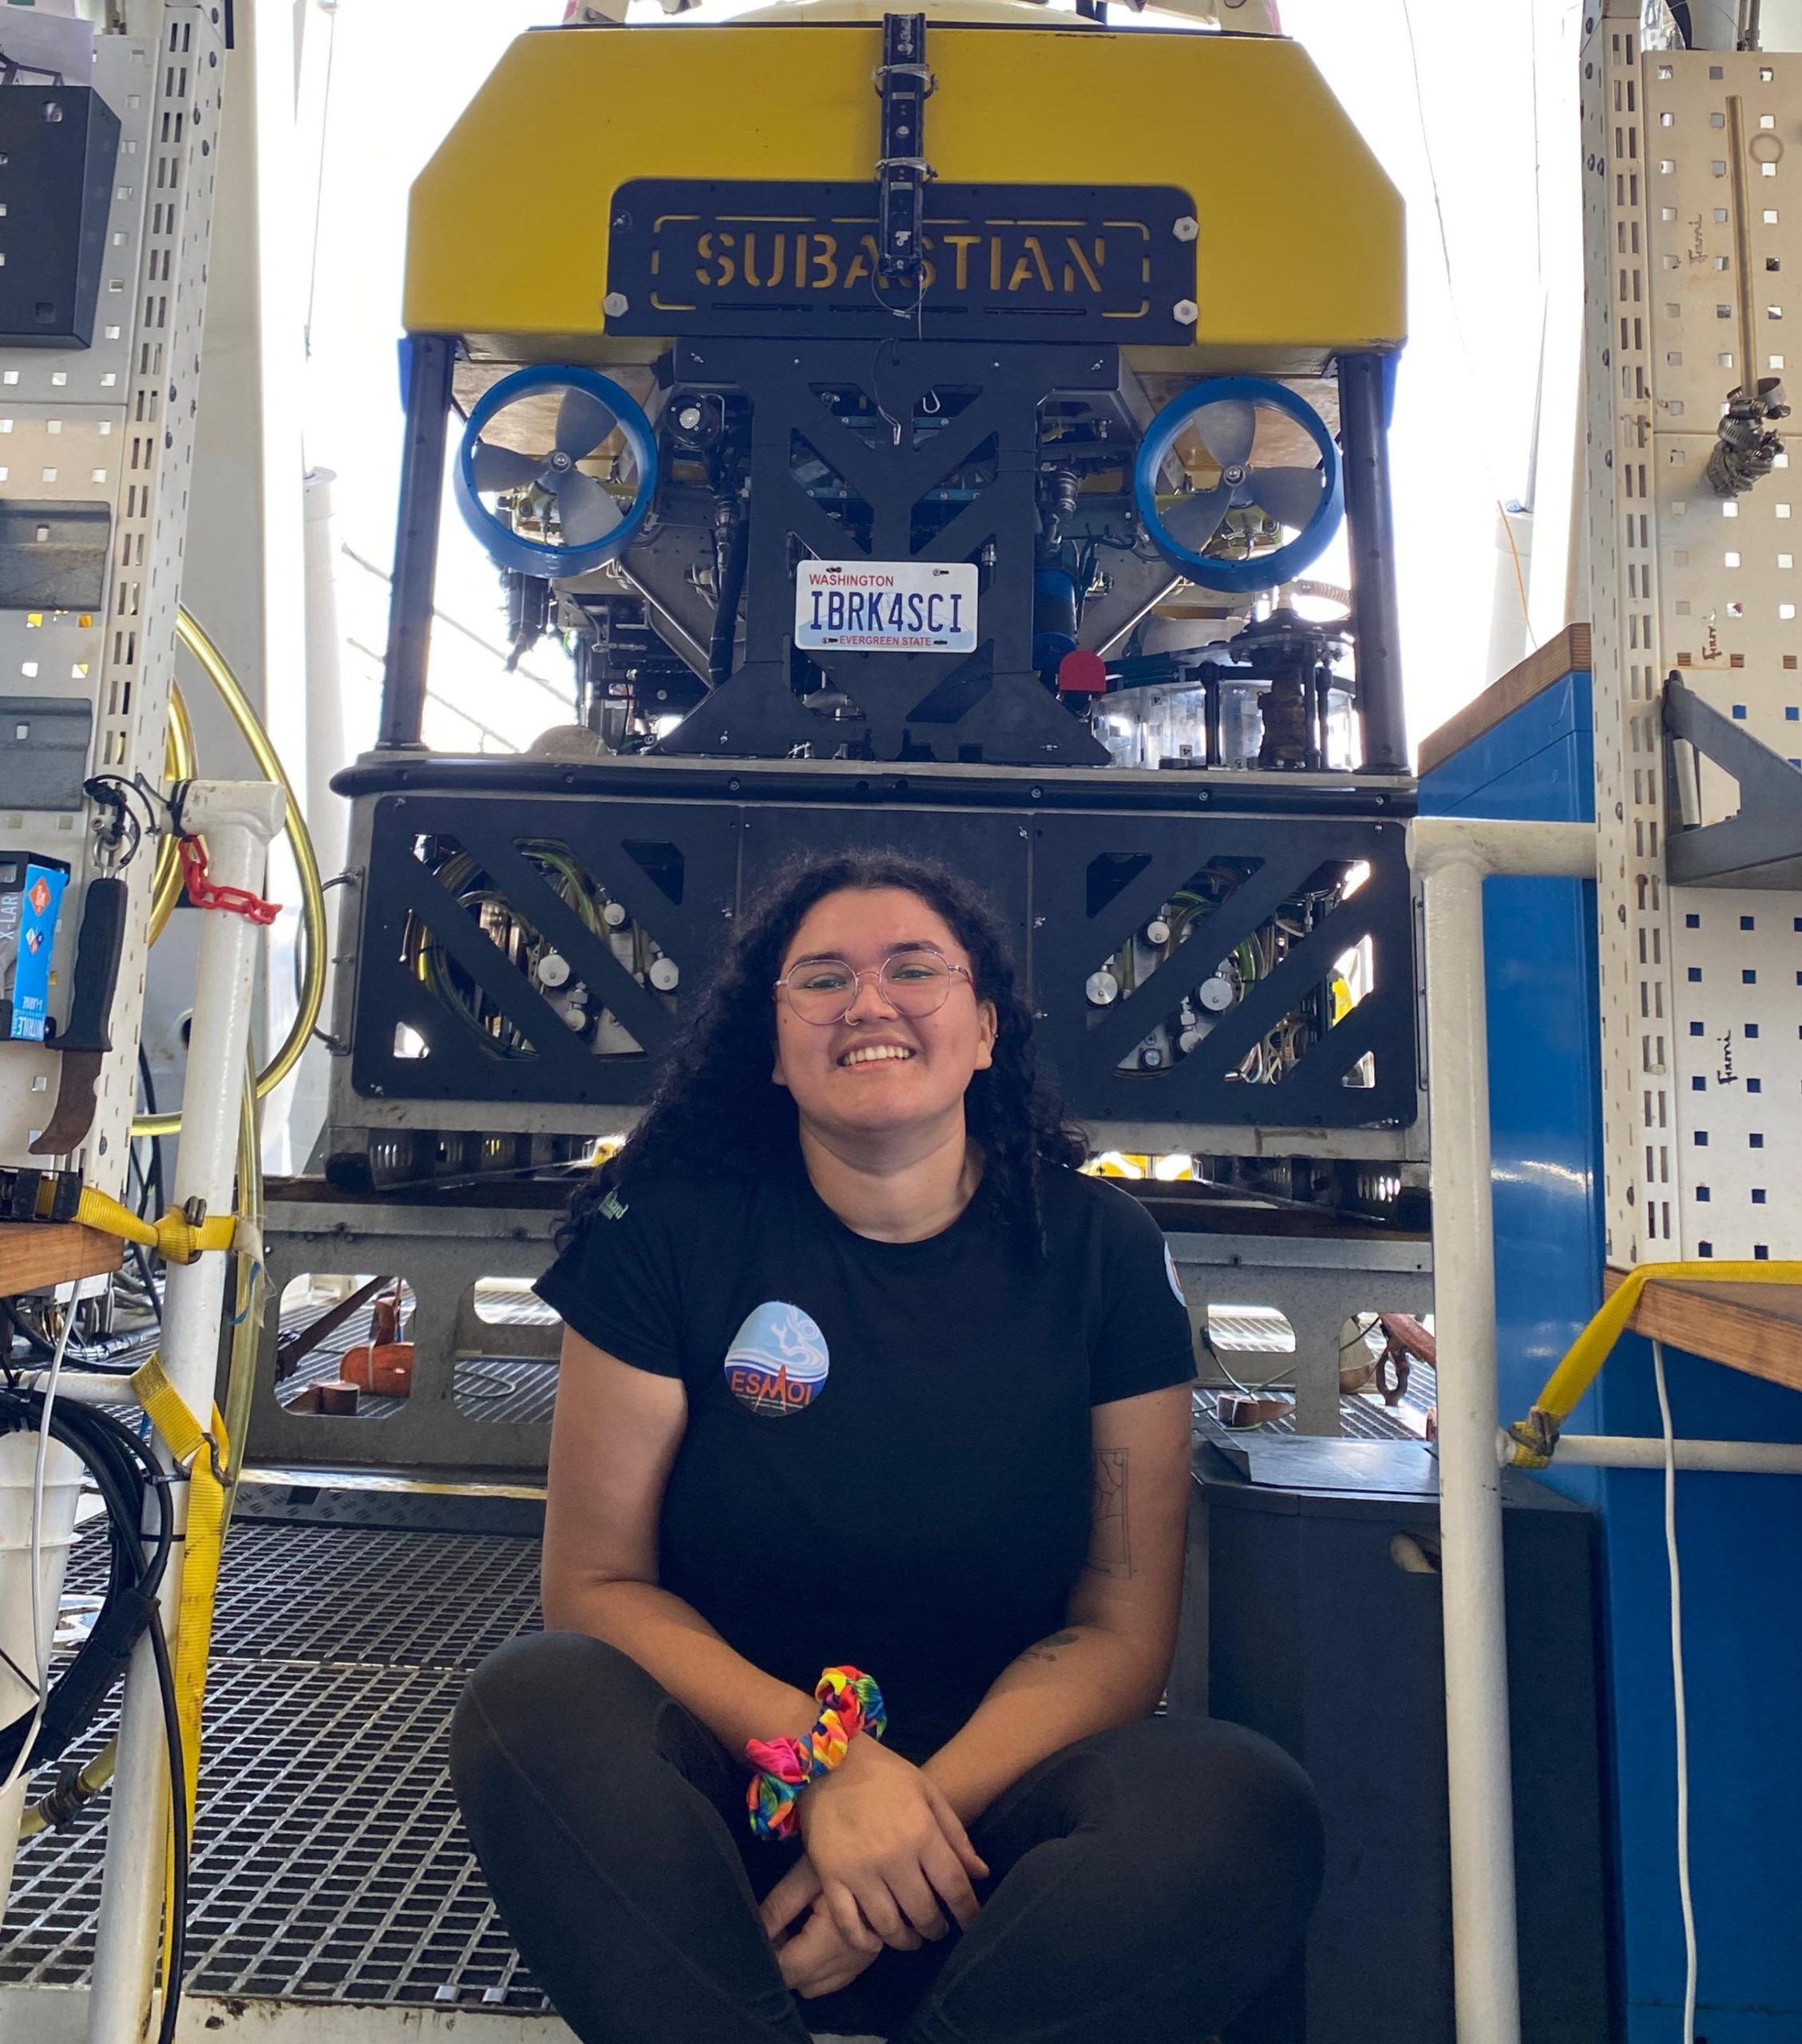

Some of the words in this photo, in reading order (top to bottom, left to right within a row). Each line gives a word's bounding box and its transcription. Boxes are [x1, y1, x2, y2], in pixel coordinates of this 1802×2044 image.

[809, 574, 894, 587] WASHINGTON
[810, 591, 962, 633] IBRK4SCI
[840, 636, 899, 646] EVERGREEN
[902, 636, 932, 647] STATE
[731, 1364, 812, 1412] ESMOI
